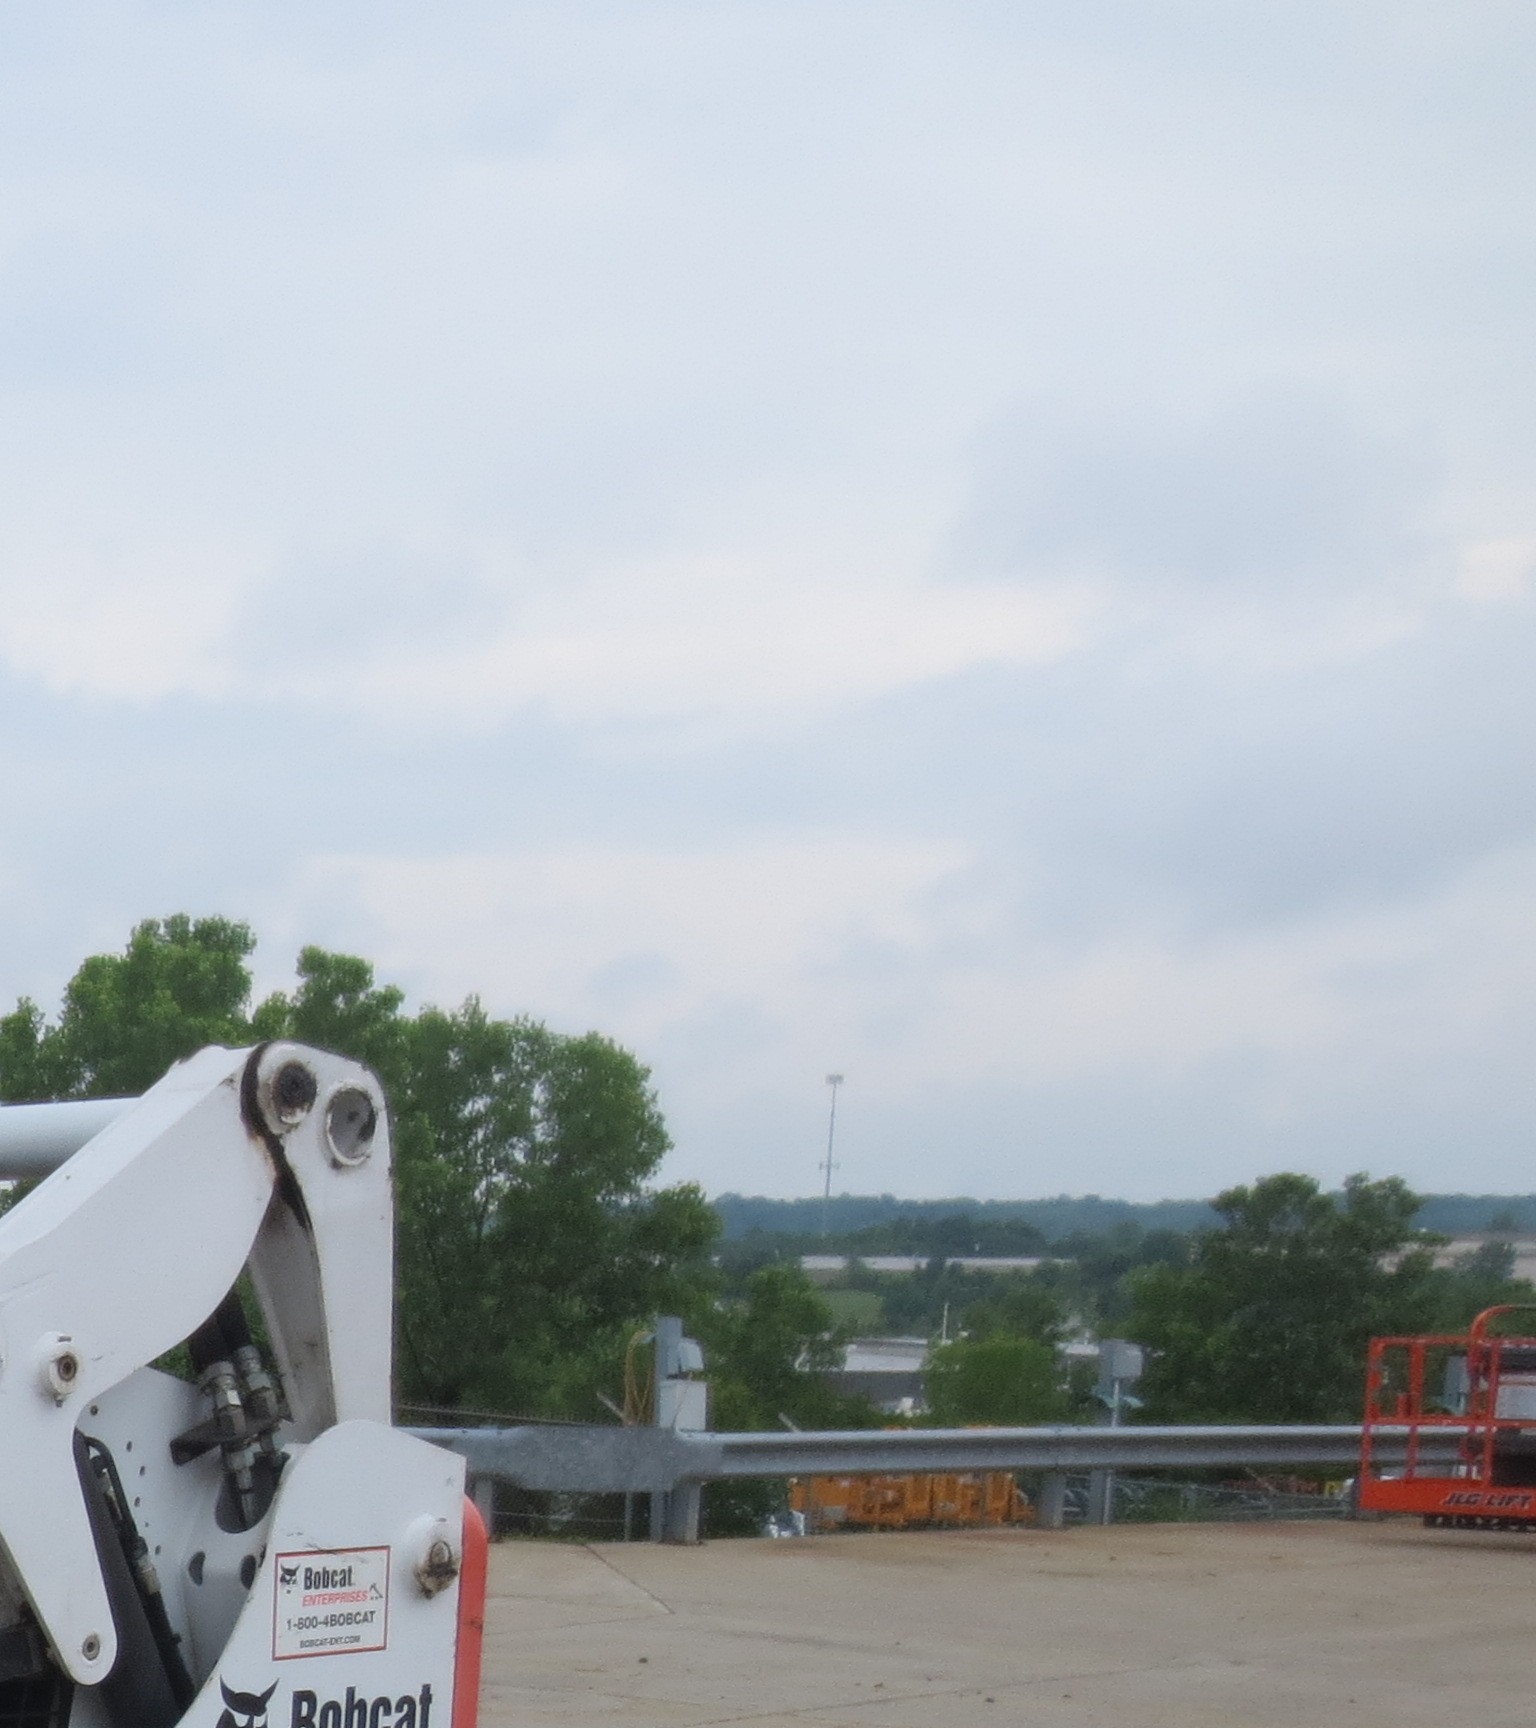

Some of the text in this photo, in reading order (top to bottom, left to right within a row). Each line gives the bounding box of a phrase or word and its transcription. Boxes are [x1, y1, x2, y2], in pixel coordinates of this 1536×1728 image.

[303, 1565, 354, 1591] Bobcat
[301, 1590, 369, 1607] ENTERPRISES
[286, 1610, 376, 1631] 1-800-4BOBCAT
